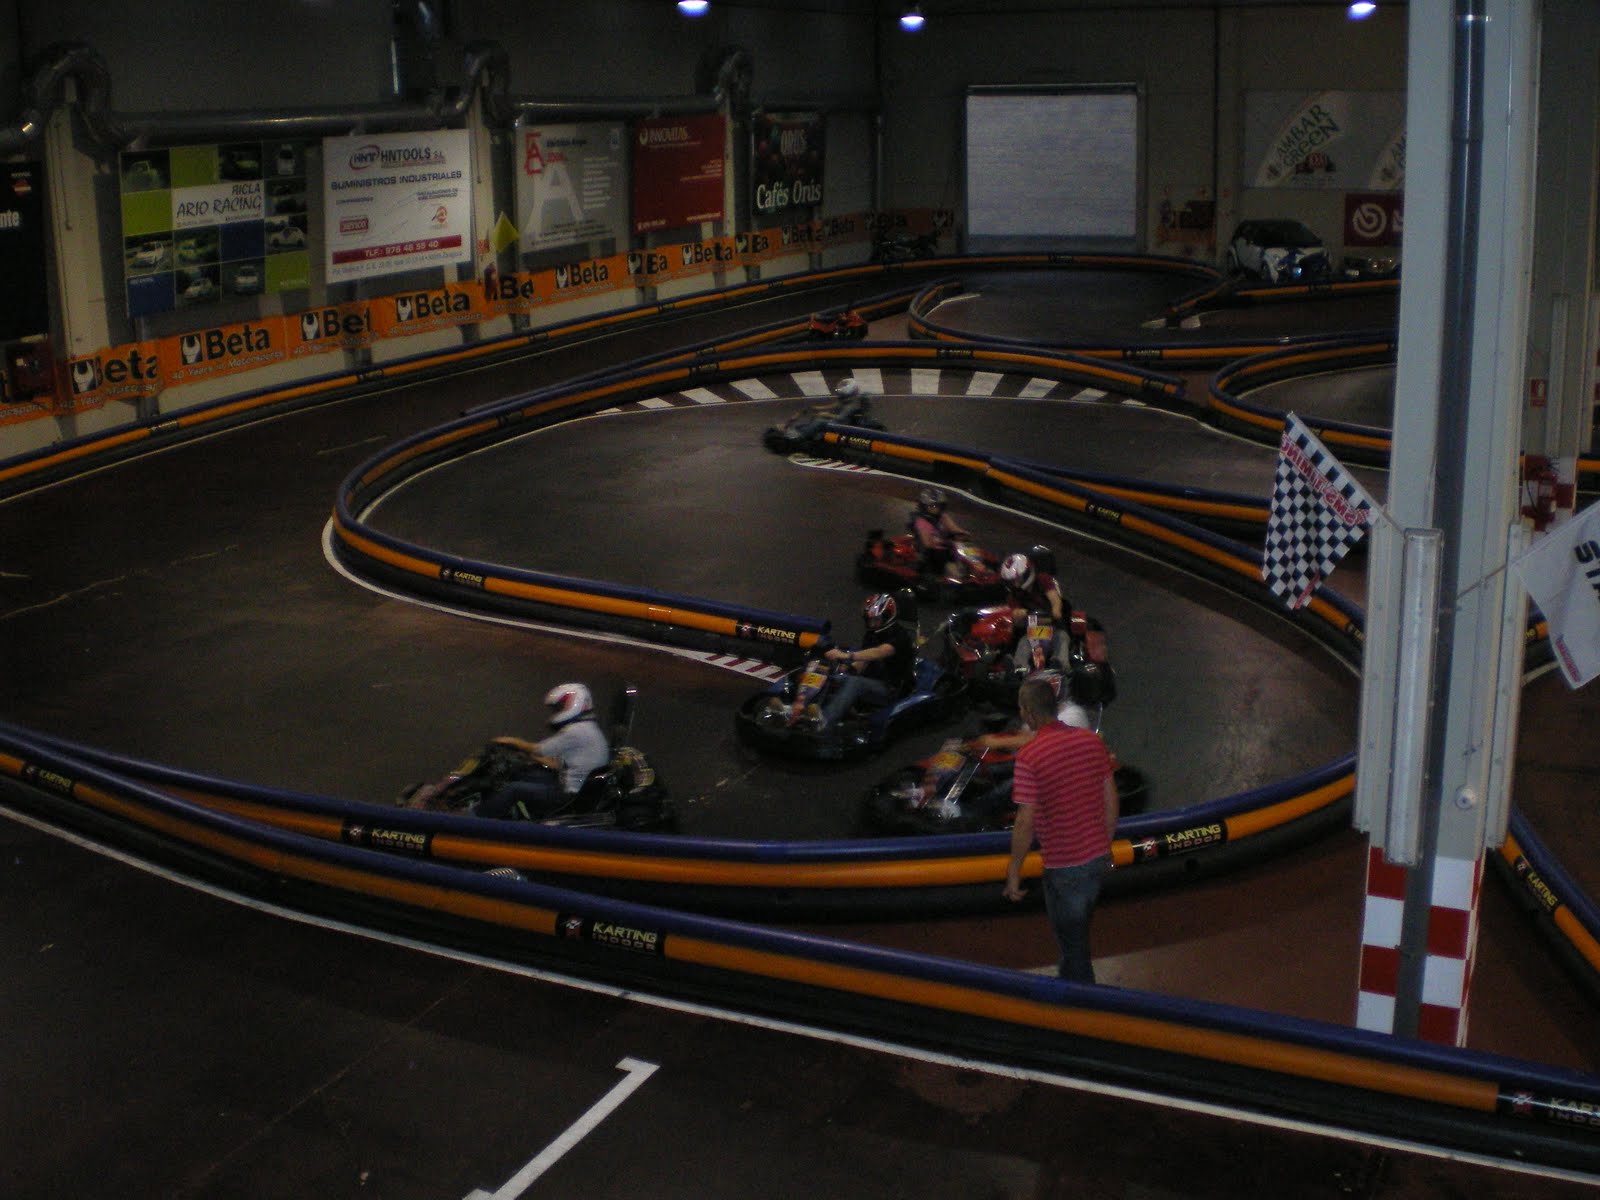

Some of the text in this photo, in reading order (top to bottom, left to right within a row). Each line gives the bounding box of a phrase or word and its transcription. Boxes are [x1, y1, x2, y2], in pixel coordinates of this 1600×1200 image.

[1276, 104, 1330, 159] AMBAR
[331, 170, 462, 190] SUMINISTROS INDUSTRIALES
[213, 195, 262, 214] RACING
[757, 181, 789, 209] Cafés
[695, 242, 733, 262] Beta
[570, 263, 609, 287] Beta
[415, 287, 470, 318] Beta
[205, 324, 270, 360] Beta
[757, 625, 796, 640] KARTING
[371, 827, 426, 844] KARTING
[1166, 823, 1222, 844] KARTING
[1527, 871, 1559, 907] KARTING
[593, 921, 658, 944] KARTING
